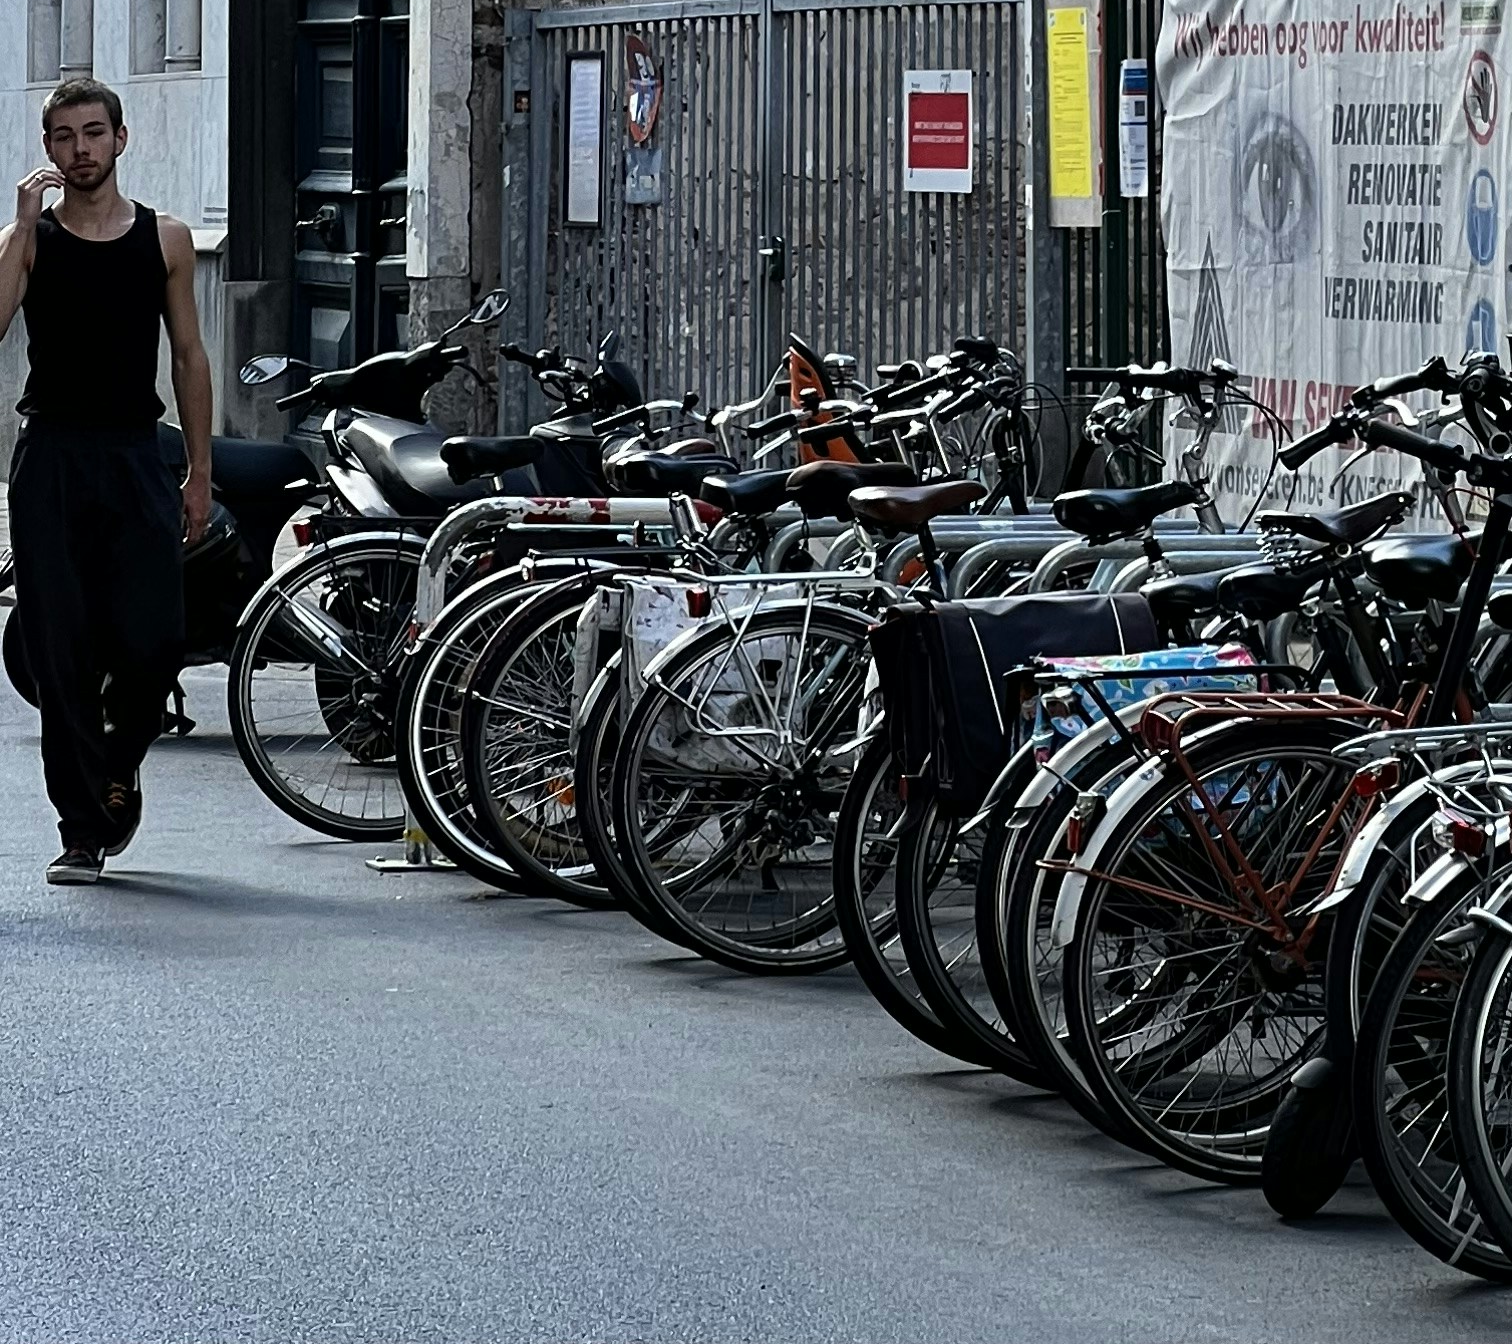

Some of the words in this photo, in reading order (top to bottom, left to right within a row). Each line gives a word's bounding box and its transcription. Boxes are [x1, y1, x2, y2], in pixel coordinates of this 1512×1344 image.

[1276, 21, 1307, 69] oog
[1313, 18, 1349, 53] voor
[1355, 0, 1445, 54] kwaliteit!
[1332, 103, 1442, 146] DAKWERKEN
[1347, 163, 1442, 206] RENOVATIE
[1362, 220, 1443, 265] SANITAIR
[1324, 277, 1444, 324] VERWARMING
